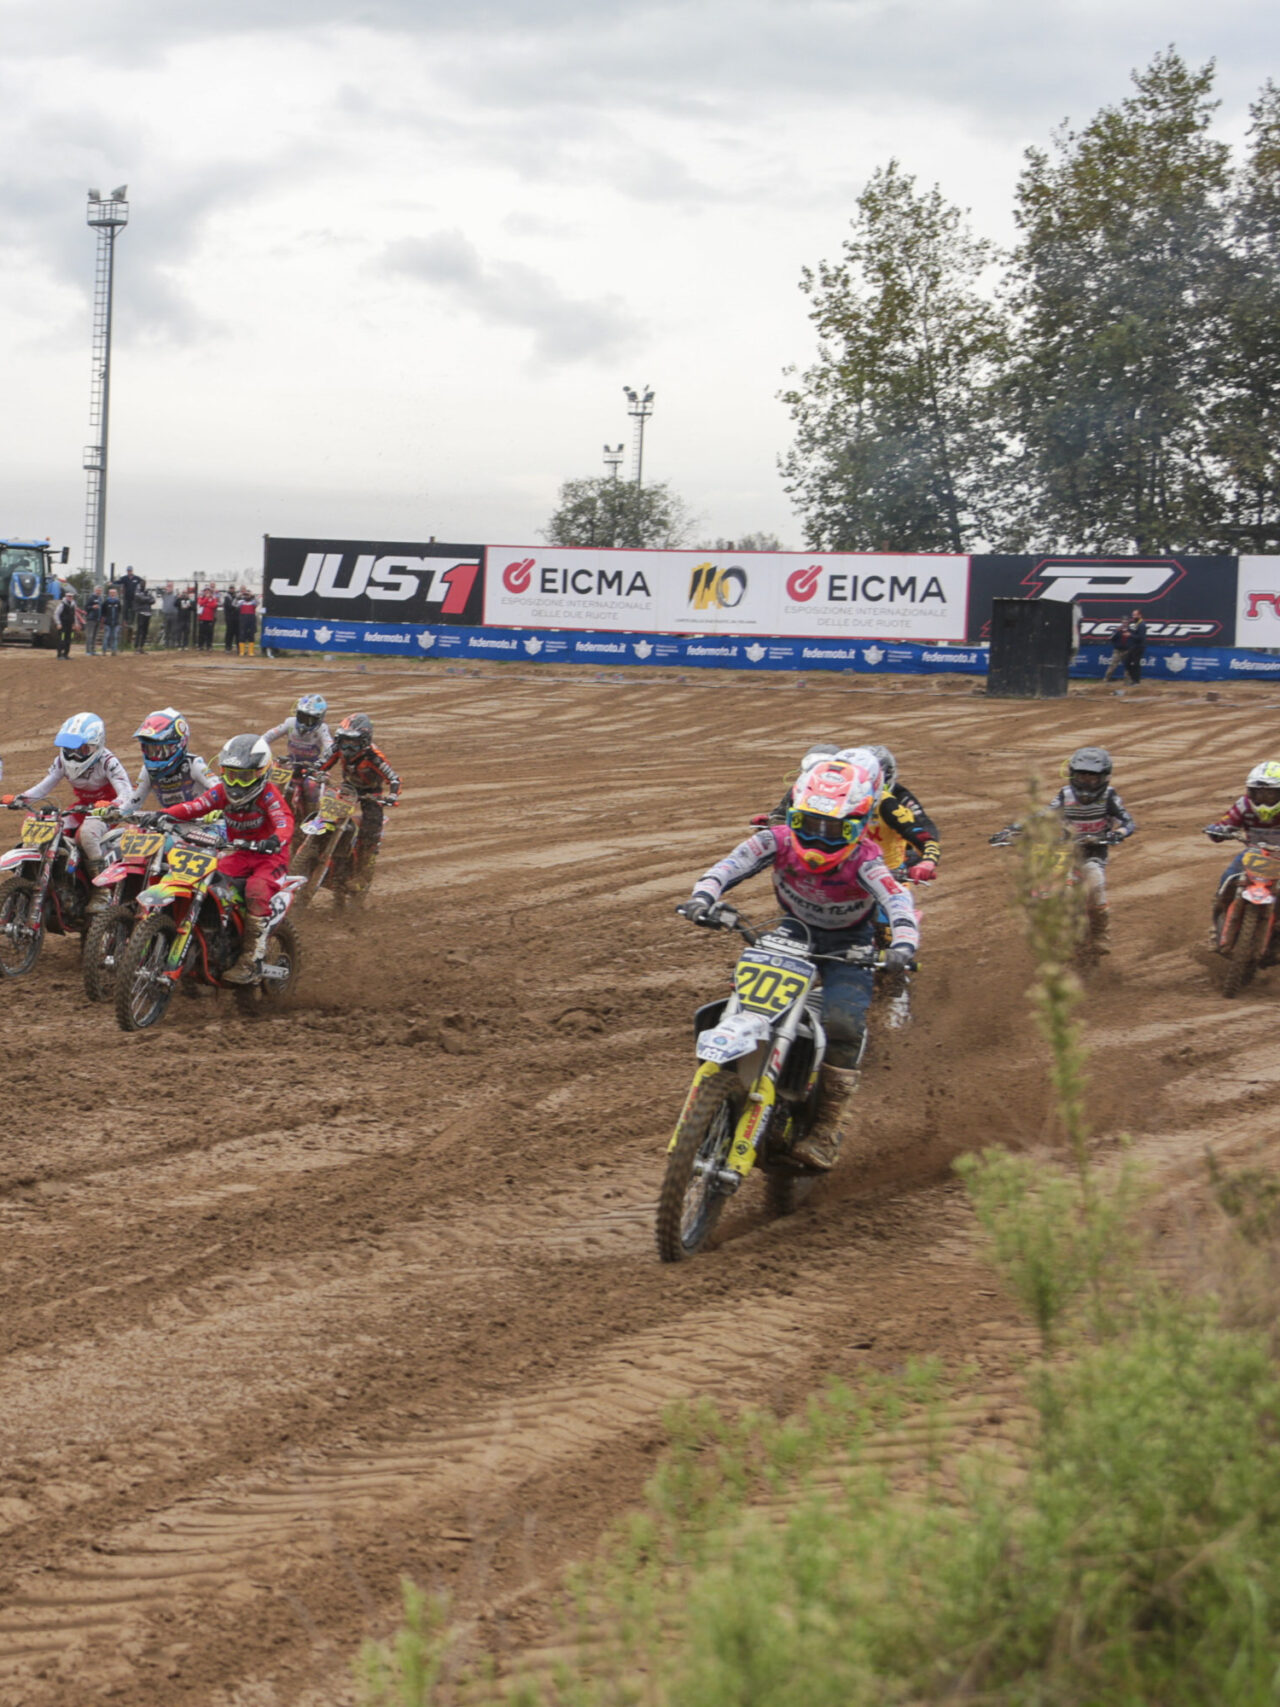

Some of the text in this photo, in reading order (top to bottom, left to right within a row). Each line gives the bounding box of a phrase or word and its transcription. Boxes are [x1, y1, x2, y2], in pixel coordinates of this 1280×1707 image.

[269, 553, 480, 614] JUST1
[540, 567, 652, 597] EICMA
[828, 574, 947, 603] EICMA
[501, 596, 652, 610] ESPOSIZIONE INTERNAZIONALE
[531, 609, 619, 621] DELLE DUE RUOTE
[784, 605, 947, 617] ESPOSIZIONE INTERNAZIONALE
[817, 618, 912, 629] DELLE DUE RUOTE
[263, 626, 309, 639] federmoto.it
[363, 631, 411, 644] federmoto.it
[468, 637, 518, 649] federmoto.it
[575, 641, 626, 653] federmoto.it
[686, 645, 738, 656] federmoto.it
[802, 648, 855, 660] federmoto.it
[922, 651, 978, 664] federmoto.it
[122, 835, 161, 858] 327
[170, 850, 211, 878] 33
[737, 965, 806, 1011] 203
